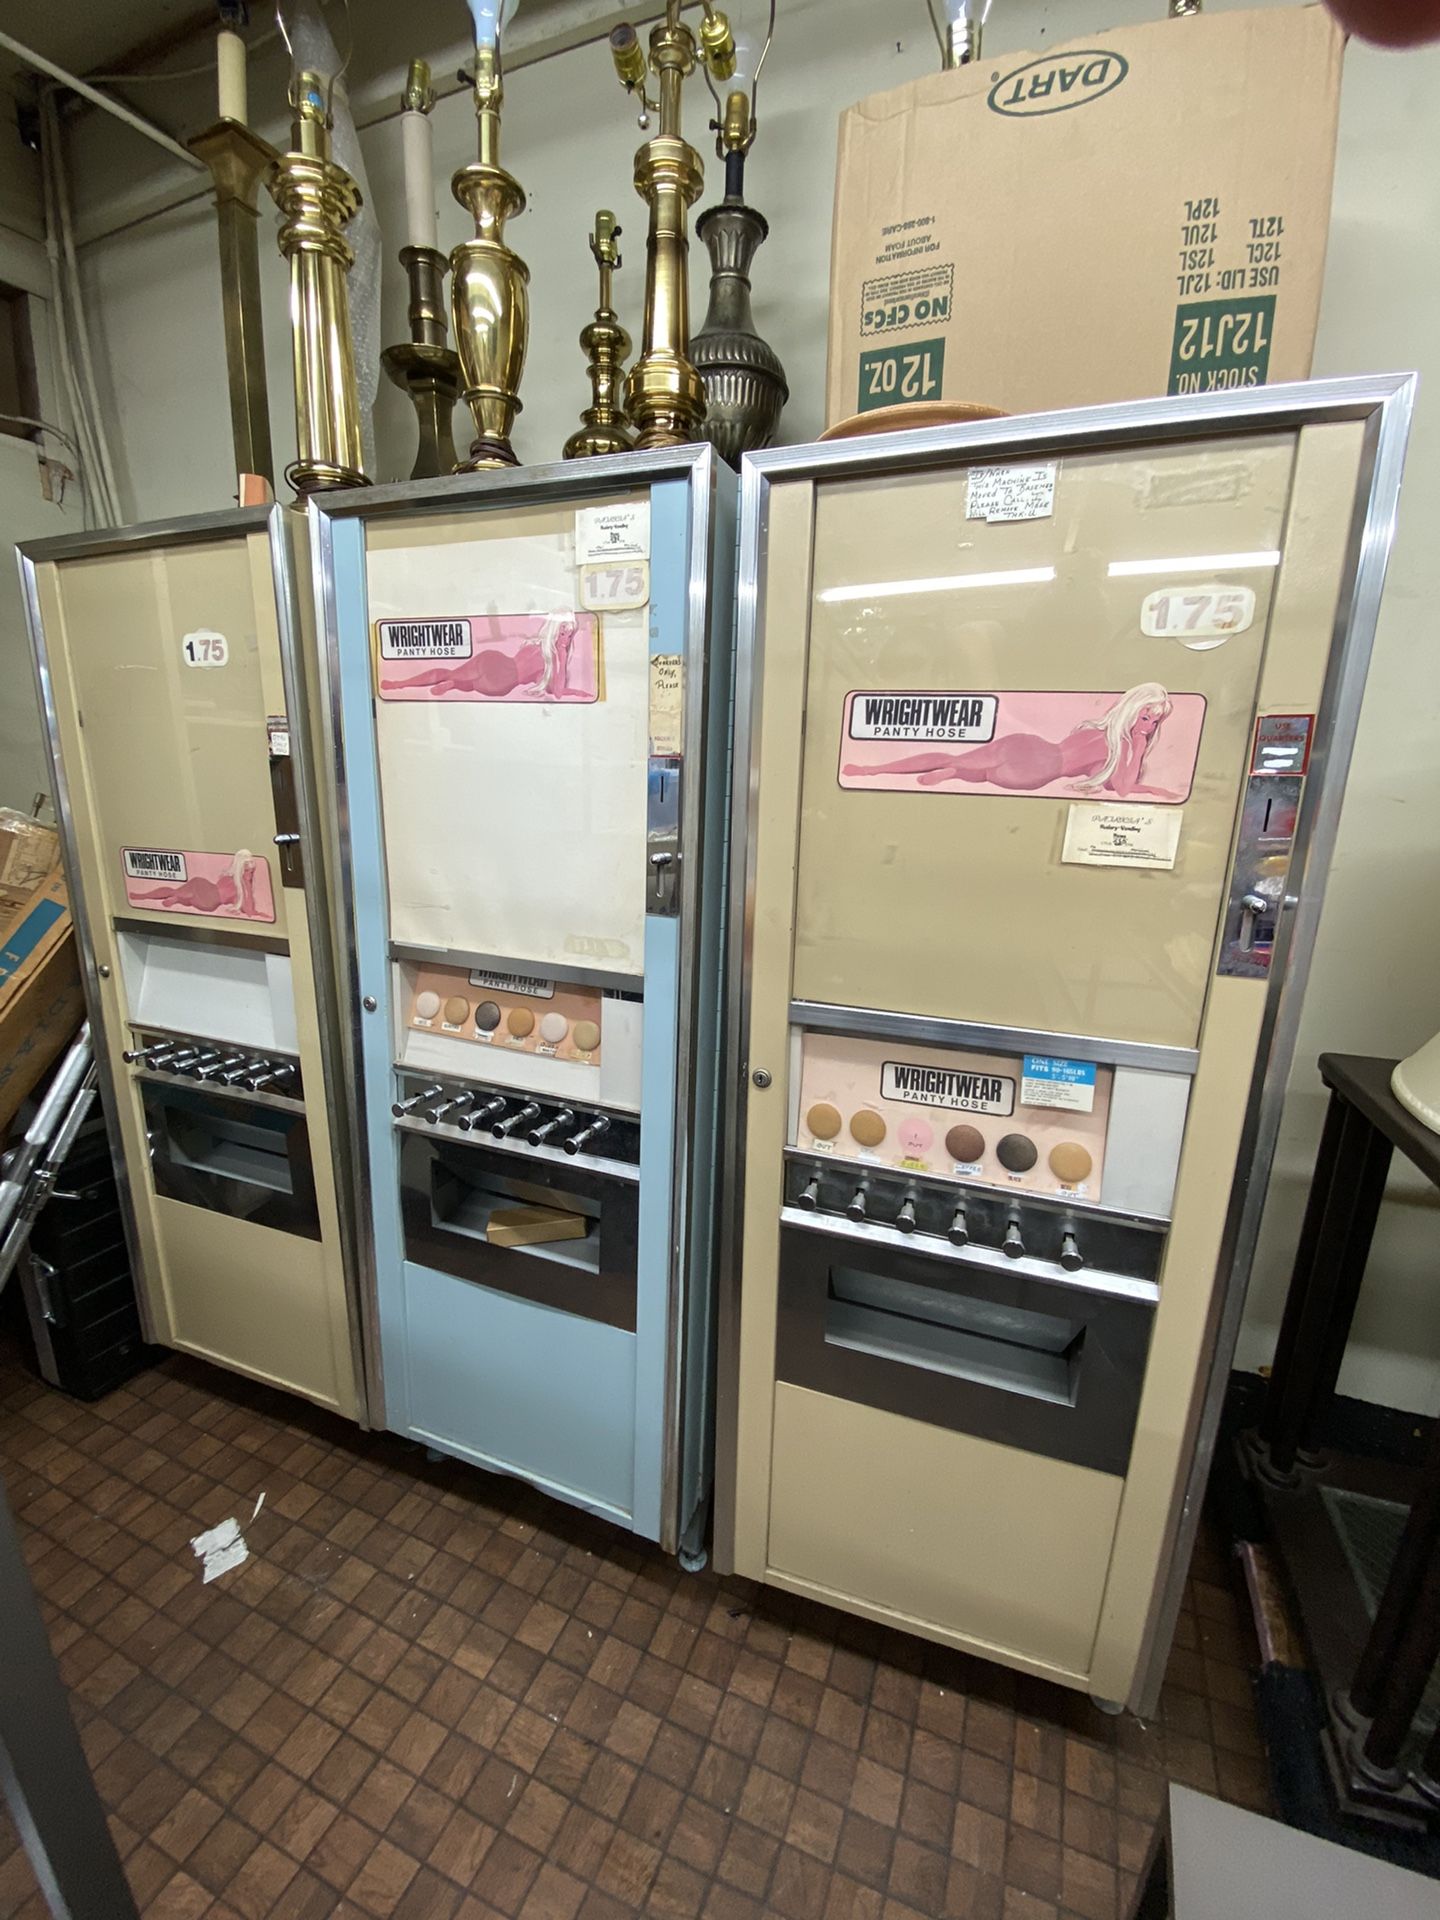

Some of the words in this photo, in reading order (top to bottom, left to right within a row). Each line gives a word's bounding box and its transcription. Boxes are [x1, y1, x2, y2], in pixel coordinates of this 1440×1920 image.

[1003, 58, 1111, 106] DART
[1184, 198, 1220, 222] 12PL
[1181, 223, 1218, 246] 12UL
[1249, 216, 1285, 239] 12TL
[885, 239, 906, 253] FOAM
[906, 234, 932, 249] ABOUT
[926, 241, 940, 252] FOR
[1246, 242, 1281, 264] 12CL
[875, 245, 926, 265] INFORMATION
[1179, 248, 1215, 271] 12SL
[1177, 272, 1212, 296] 12JL
[1216, 268, 1246, 291] LID:
[1250, 265, 1279, 287] USE
[864, 303, 910, 330] CFCs
[914, 295, 949, 321] NO
[1179, 311, 1267, 361] 12J12
[864, 358, 897, 395] OZ.
[901, 352, 936, 398] 12
[1176, 372, 1201, 396] NO.
[1206, 365, 1259, 393] STOCK
[585, 567, 645, 598] 1.75
[1149, 593, 1245, 631] 1.75
[388, 623, 464, 648] WRIGHTWEAR
[185, 639, 225, 662] 1.75
[397, 648, 427, 656] PANTY
[430, 646, 456, 656] HOSE
[865, 699, 983, 727] WRIGHTWEAR
[874, 726, 921, 737] PANTY
[925, 727, 966, 738] HOSE
[129, 852, 181, 872] WRIGHTWEAR
[158, 871, 177, 879] HOSE
[482, 979, 510, 989] PANTY
[513, 984, 538, 995] HOSE
[894, 1066, 1003, 1103] WRIGHTWEAR
[903, 1090, 945, 1104] PANTY
[950, 1097, 988, 1110] HOSE
